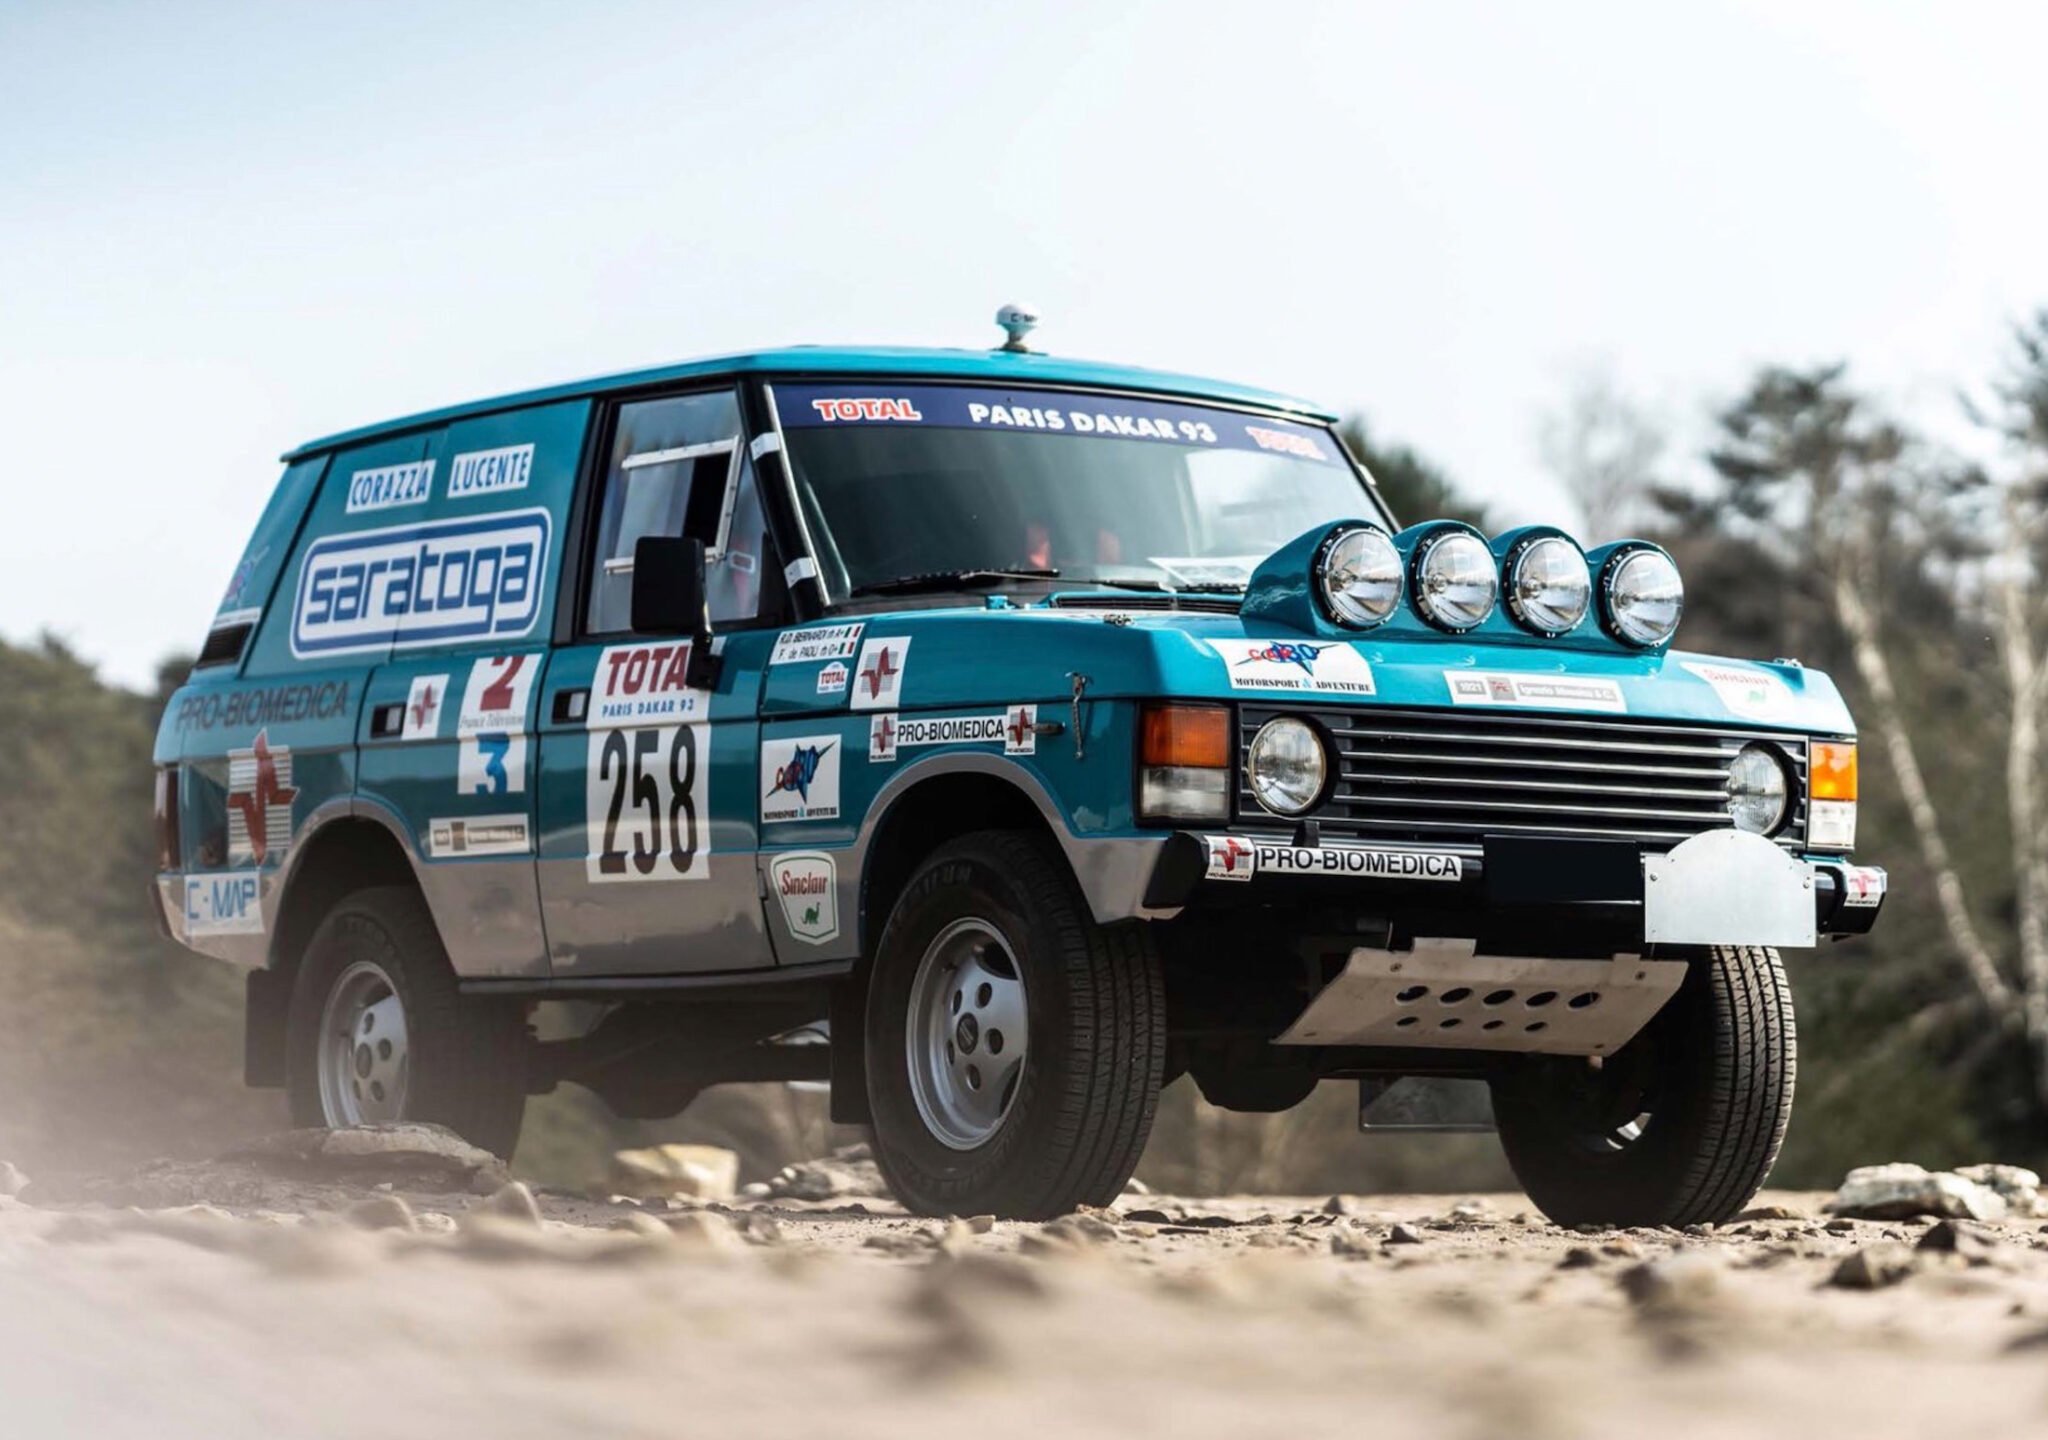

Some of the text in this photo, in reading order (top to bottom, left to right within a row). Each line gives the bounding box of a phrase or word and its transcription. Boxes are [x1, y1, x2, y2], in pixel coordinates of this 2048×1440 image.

[812, 399, 922, 421] TOTAL
[968, 403, 1217, 443] PARIS DAKAR 93
[352, 467, 430, 506] CORAZZA
[453, 451, 529, 491] LUCENTE
[306, 544, 534, 633] saratoga
[480, 656, 525, 710] 2
[606, 645, 690, 696] TOTA
[821, 669, 845, 684] TOTAL
[1235, 677, 1300, 689] MOTORSPORT
[1315, 681, 1372, 692] ADVENTURE
[175, 680, 348, 732] PRO-BIOMEDICA
[602, 698, 694, 717] PARIS DAKAR 93
[898, 719, 1005, 742] PRO-BIOMEDICA
[476, 732, 510, 797] 3
[599, 724, 698, 874] 258
[1260, 847, 1458, 877] PRO-BIOMEDICA
[782, 870, 828, 895] Sinclair
